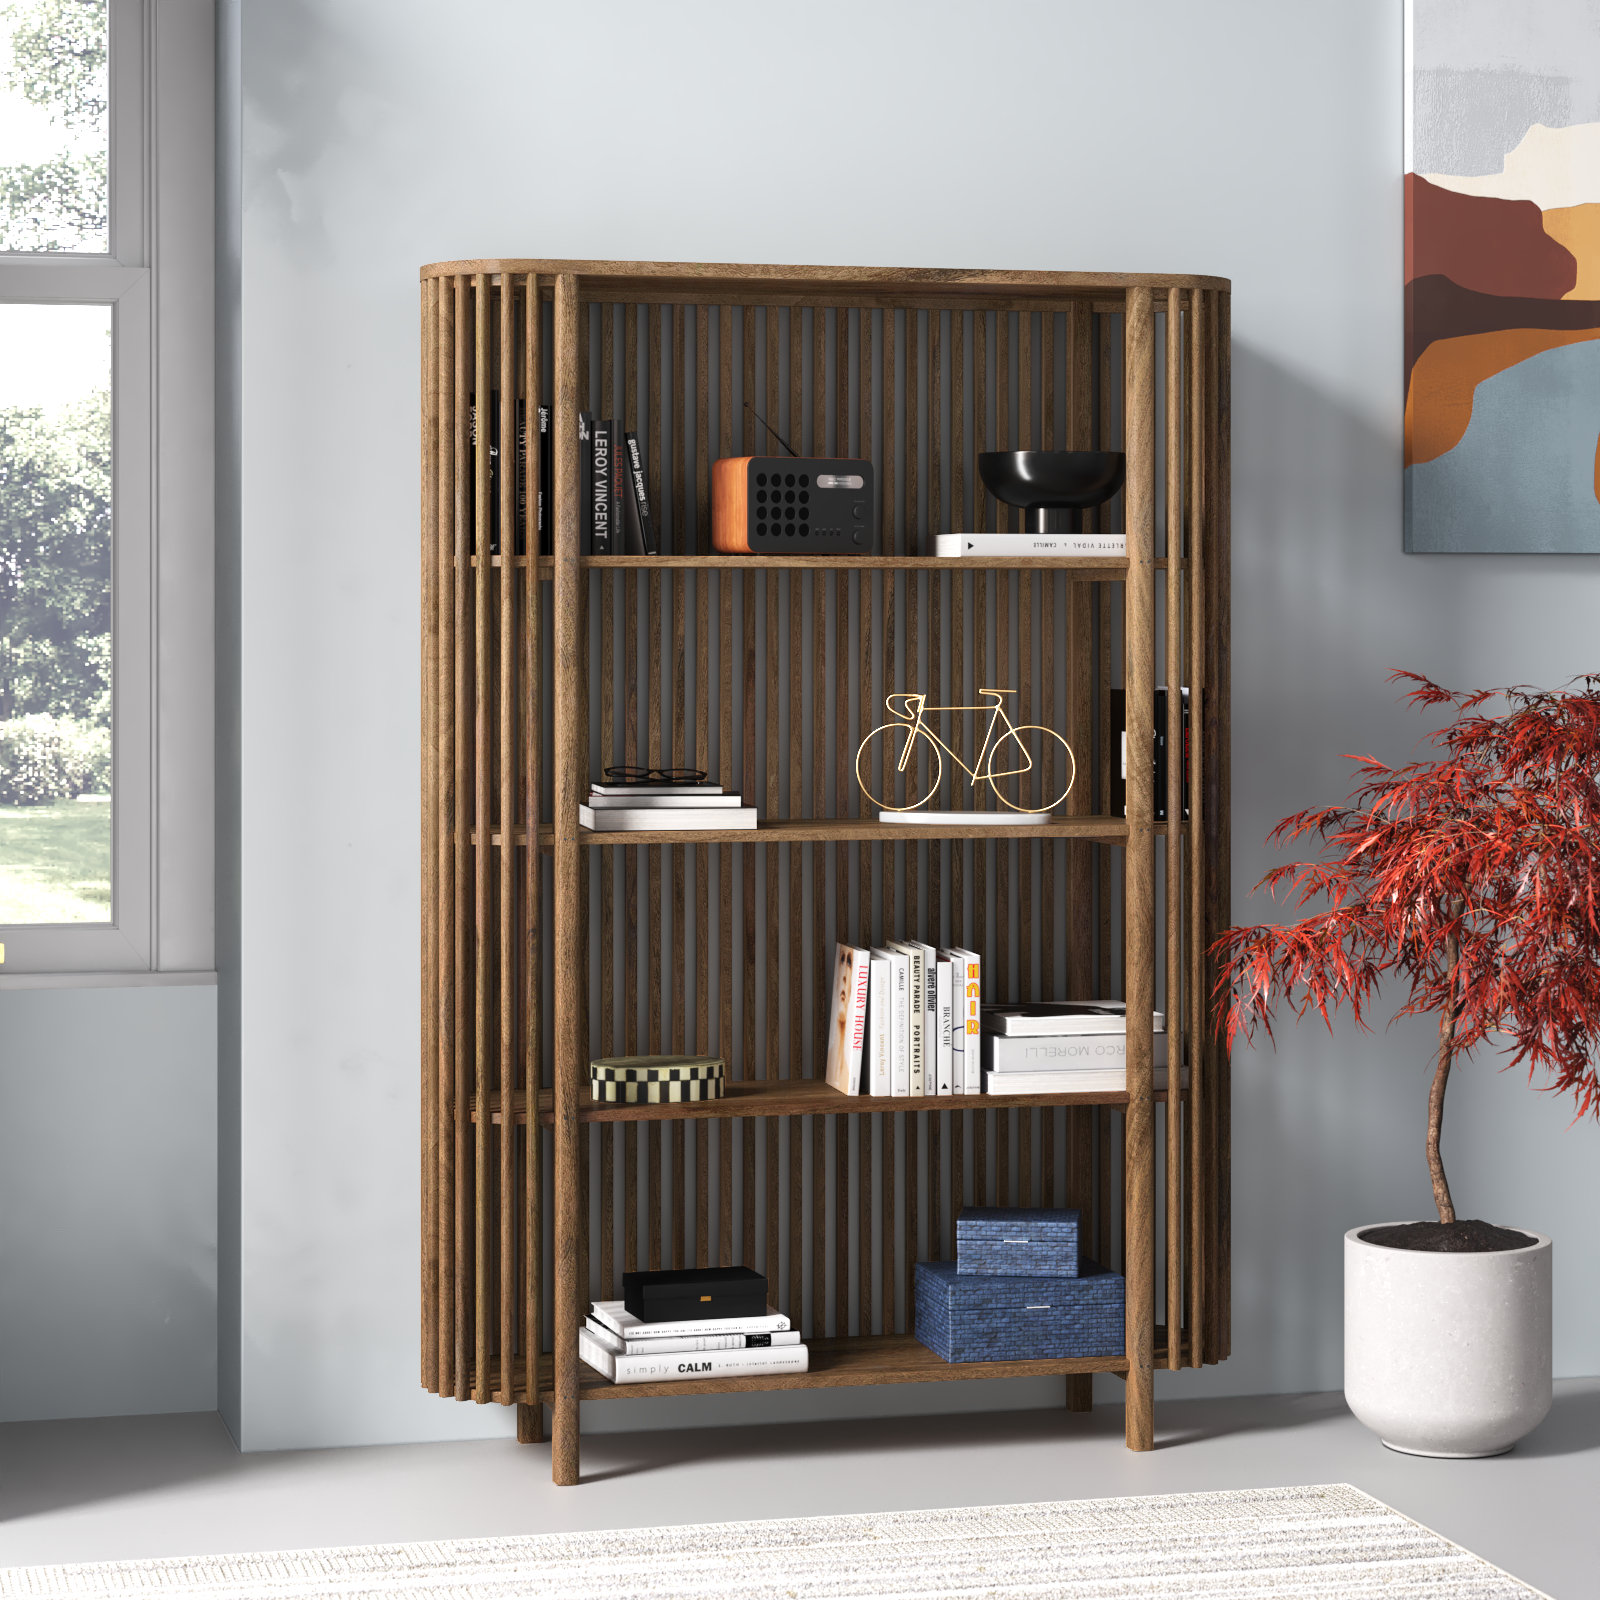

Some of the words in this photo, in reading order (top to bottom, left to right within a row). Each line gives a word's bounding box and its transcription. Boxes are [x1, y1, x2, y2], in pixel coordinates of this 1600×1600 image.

[594, 430, 608, 478] LEROY
[613, 444, 623, 467] JULES
[627, 438, 641, 469] gustave
[633, 470, 647, 502] jacques
[594, 479, 608, 539] VINCENT
[640, 501, 649, 517] rise
[1073, 541, 1095, 549] VIDAL
[1098, 541, 1126, 549] RLETTE
[913, 955, 921, 982] BEAUTY
[854, 964, 869, 1011] LUXURY
[913, 984, 921, 1014] PARADE
[966, 963, 980, 1036] HAIR
[852, 1014, 866, 1051] HOUSE
[942, 1006, 952, 1048] BRANCHÉ
[913, 1024, 921, 1075] PORTRAITS
[1024, 1045, 1090, 1059] MORELLI
[1094, 1044, 1126, 1056] RCO
[626, 1364, 670, 1376] simply
[677, 1361, 713, 1374] CALM
